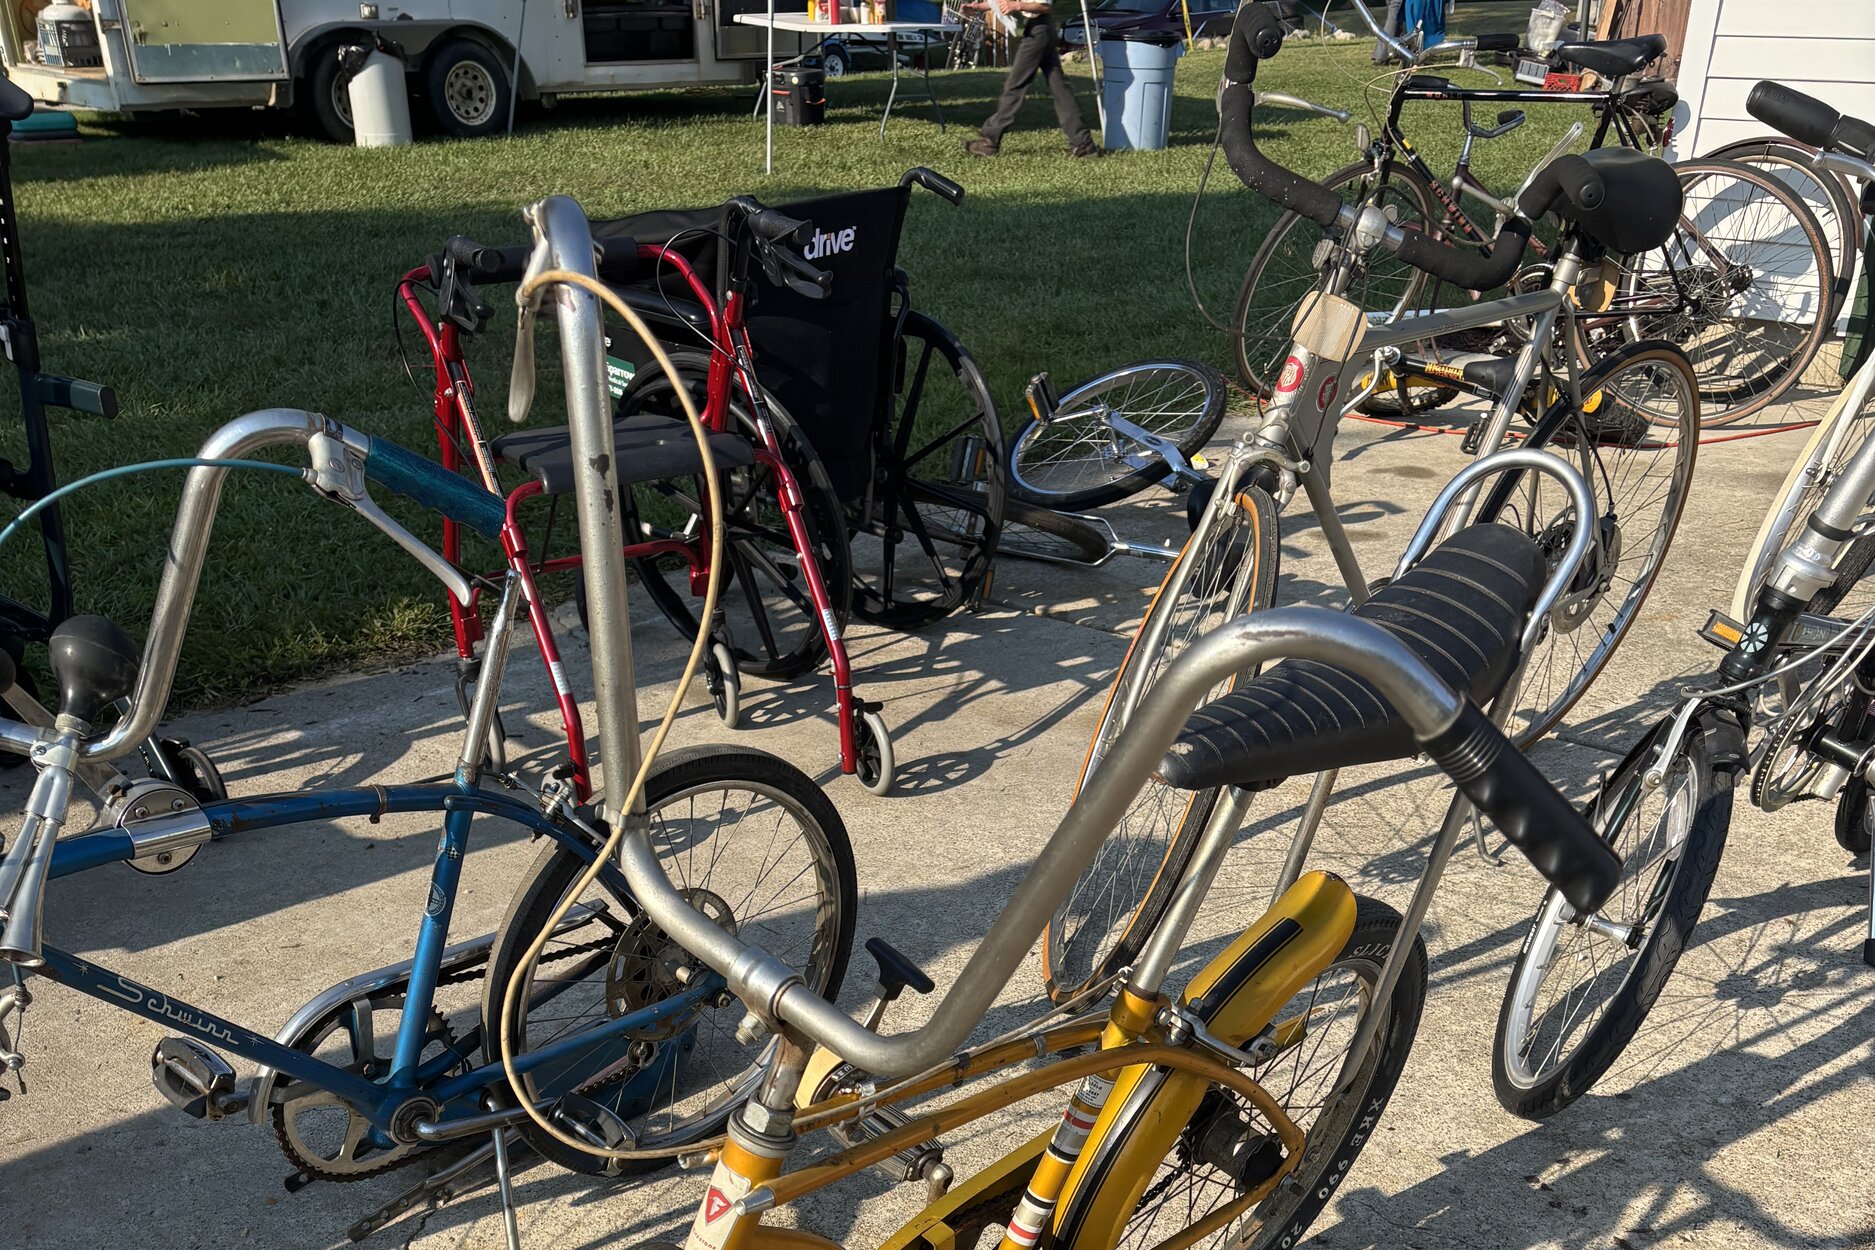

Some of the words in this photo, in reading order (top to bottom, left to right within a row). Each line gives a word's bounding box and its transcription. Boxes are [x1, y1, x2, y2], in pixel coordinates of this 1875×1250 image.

[1428, 179, 1473, 235] SCHWINN
[803, 227, 855, 260] drive
[1347, 943, 1392, 959] SLIC
[96, 976, 240, 1045] Schwinn
[1351, 1096, 1384, 1148] XKE
[1318, 1158, 1349, 1200] 990
[1281, 1221, 1303, 1250] 20
